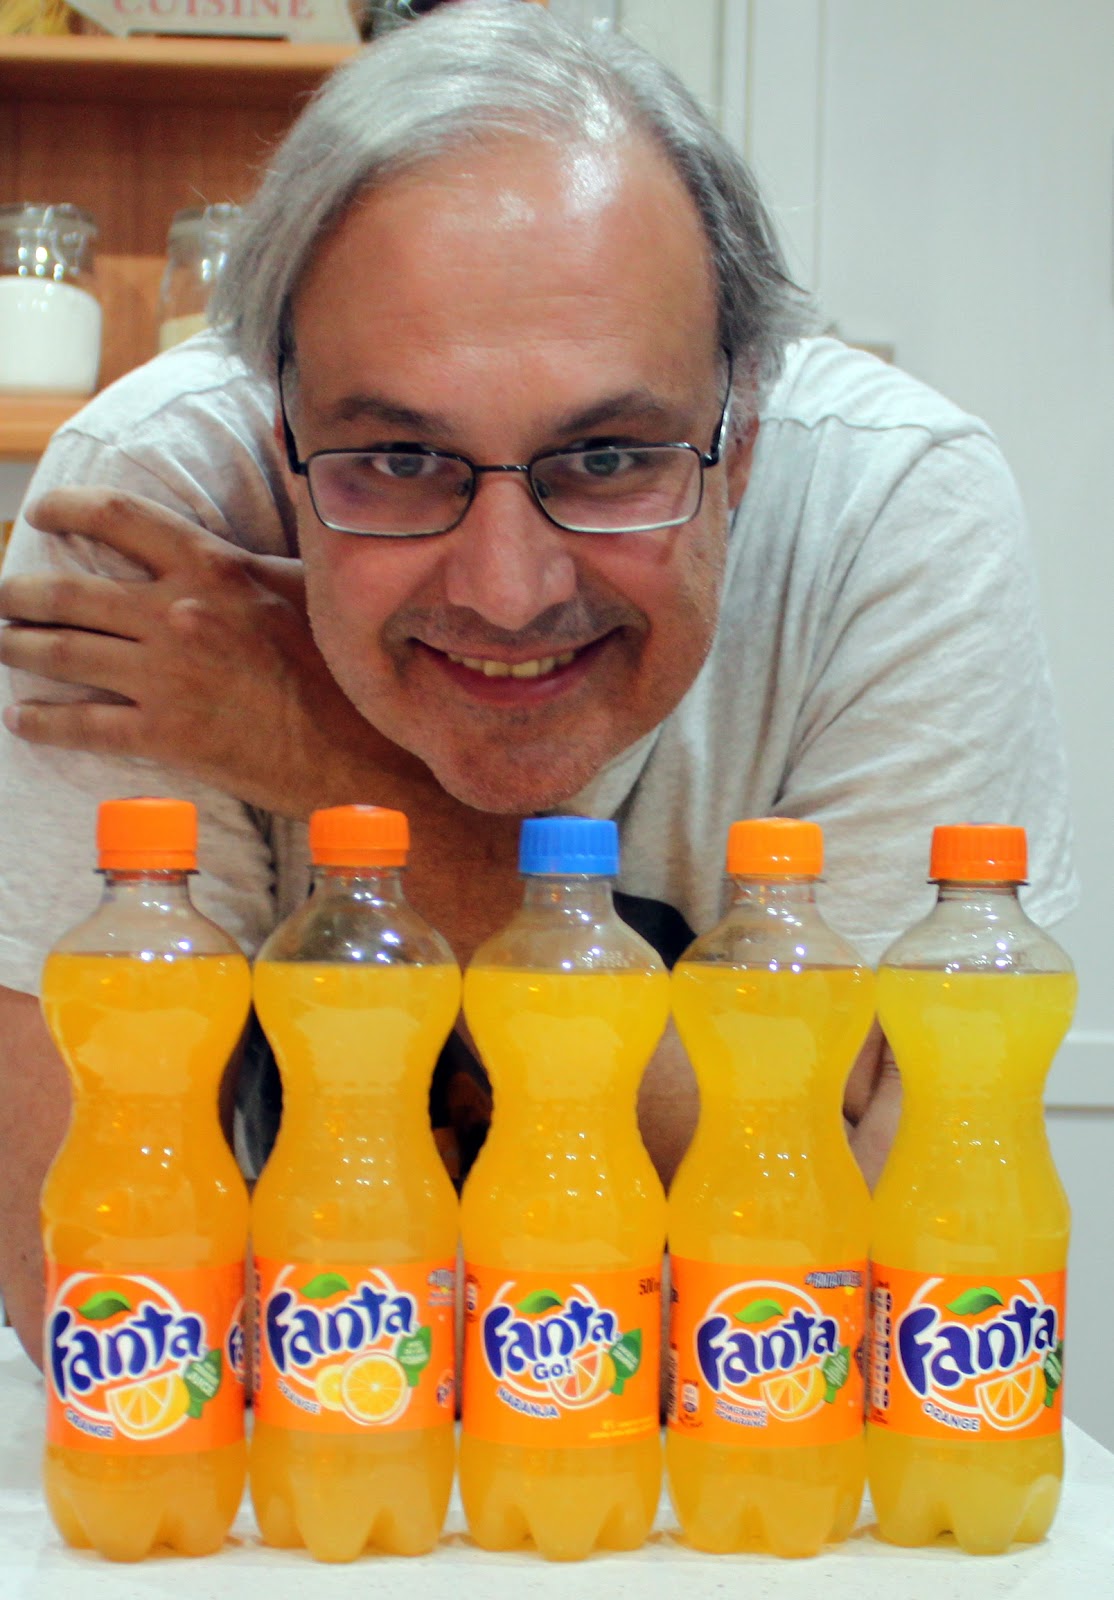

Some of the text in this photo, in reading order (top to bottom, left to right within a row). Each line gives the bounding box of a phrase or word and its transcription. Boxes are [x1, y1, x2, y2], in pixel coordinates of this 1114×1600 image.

[50, 1308, 202, 1401] Fanta
[266, 1285, 414, 1374] Fanta
[482, 1299, 615, 1378] Fanta
[696, 1309, 837, 1392] Fanta
[899, 1298, 1056, 1397] Fanta
[498, 1387, 559, 1418] NARANJA
[924, 1403, 980, 1431] ORANGE
